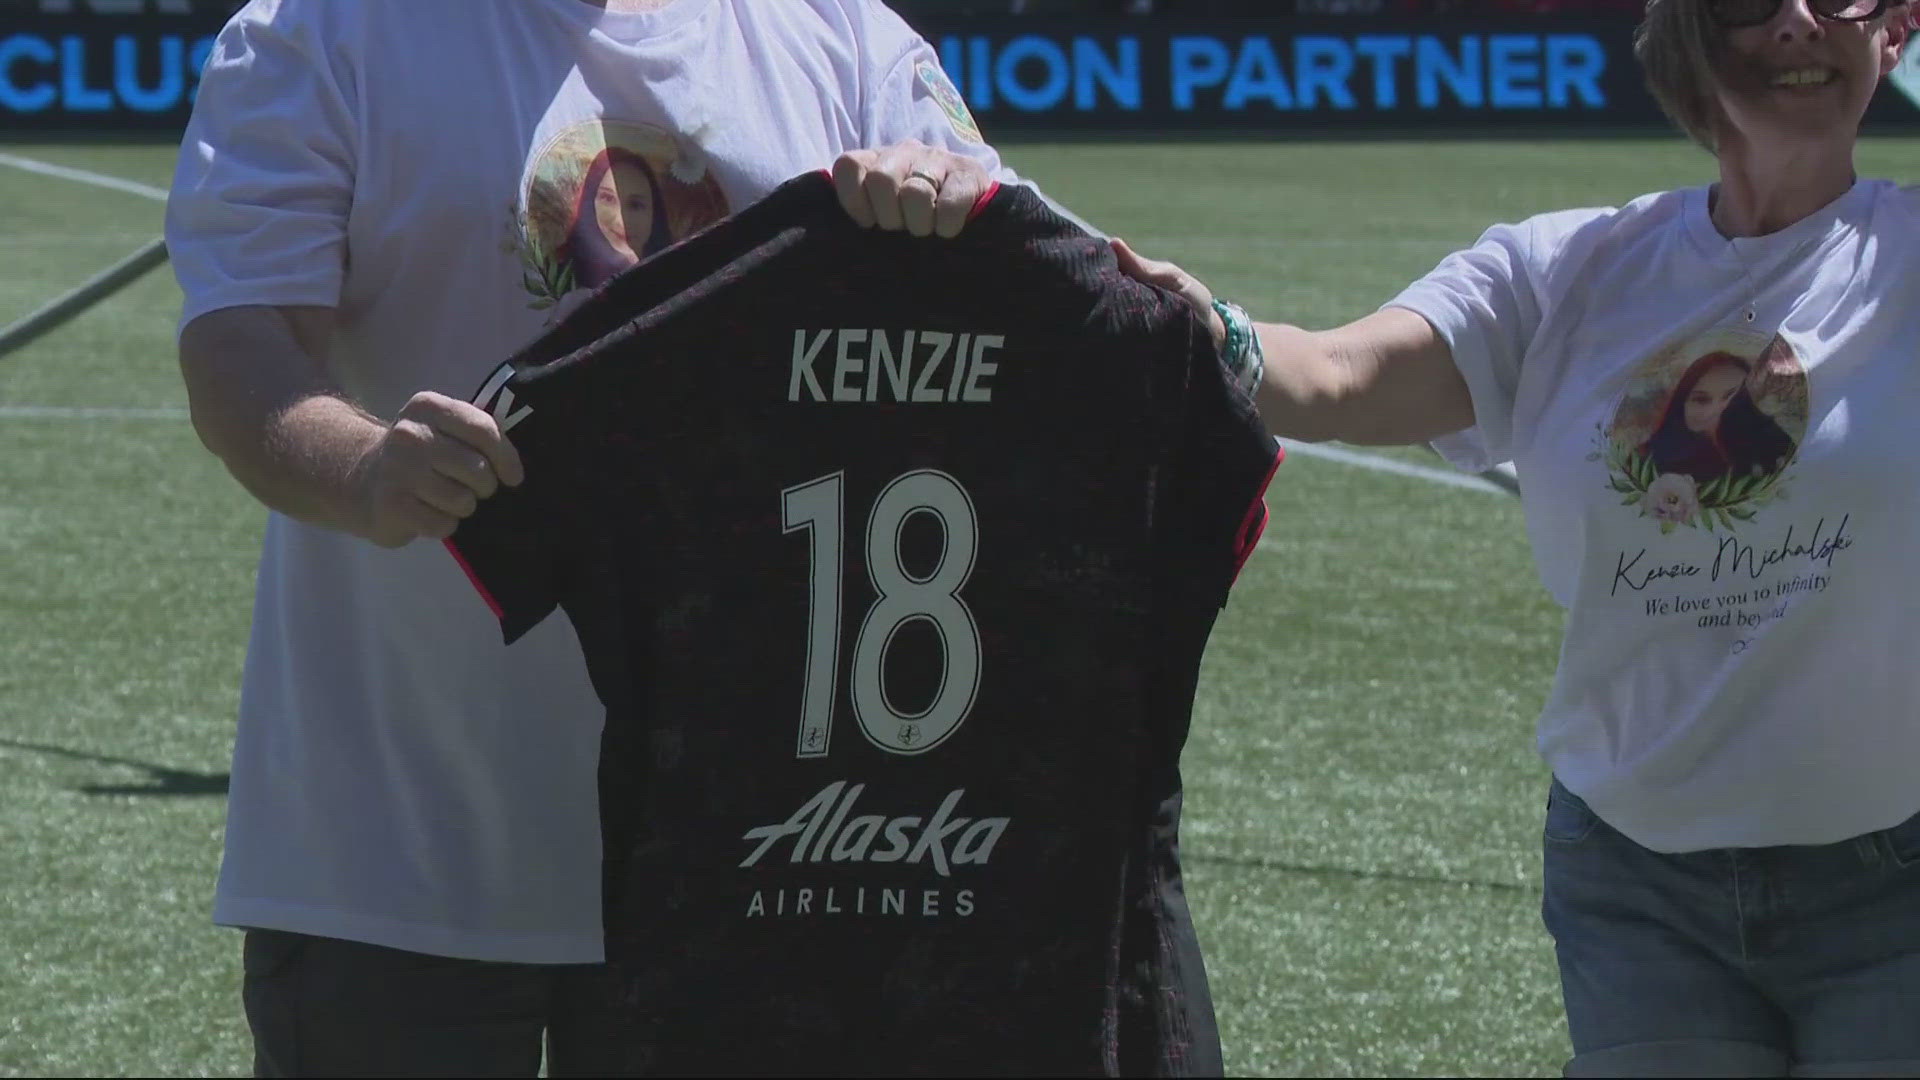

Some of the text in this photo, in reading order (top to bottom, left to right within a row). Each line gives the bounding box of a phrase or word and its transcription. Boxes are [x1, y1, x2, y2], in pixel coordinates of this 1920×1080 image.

[1168, 34, 1608, 111] PARTNER
[788, 328, 1005, 403] KENZIE
[1611, 548, 1701, 597] Kenzie
[1645, 598, 1670, 616] We
[1674, 596, 1711, 614] love
[1716, 593, 1748, 611] you
[1776, 573, 1832, 597] infinity
[780, 466, 983, 759] 18
[1697, 612, 1732, 628] and
[738, 780, 1011, 877] Alaska
[746, 887, 975, 917] AIRLINES
